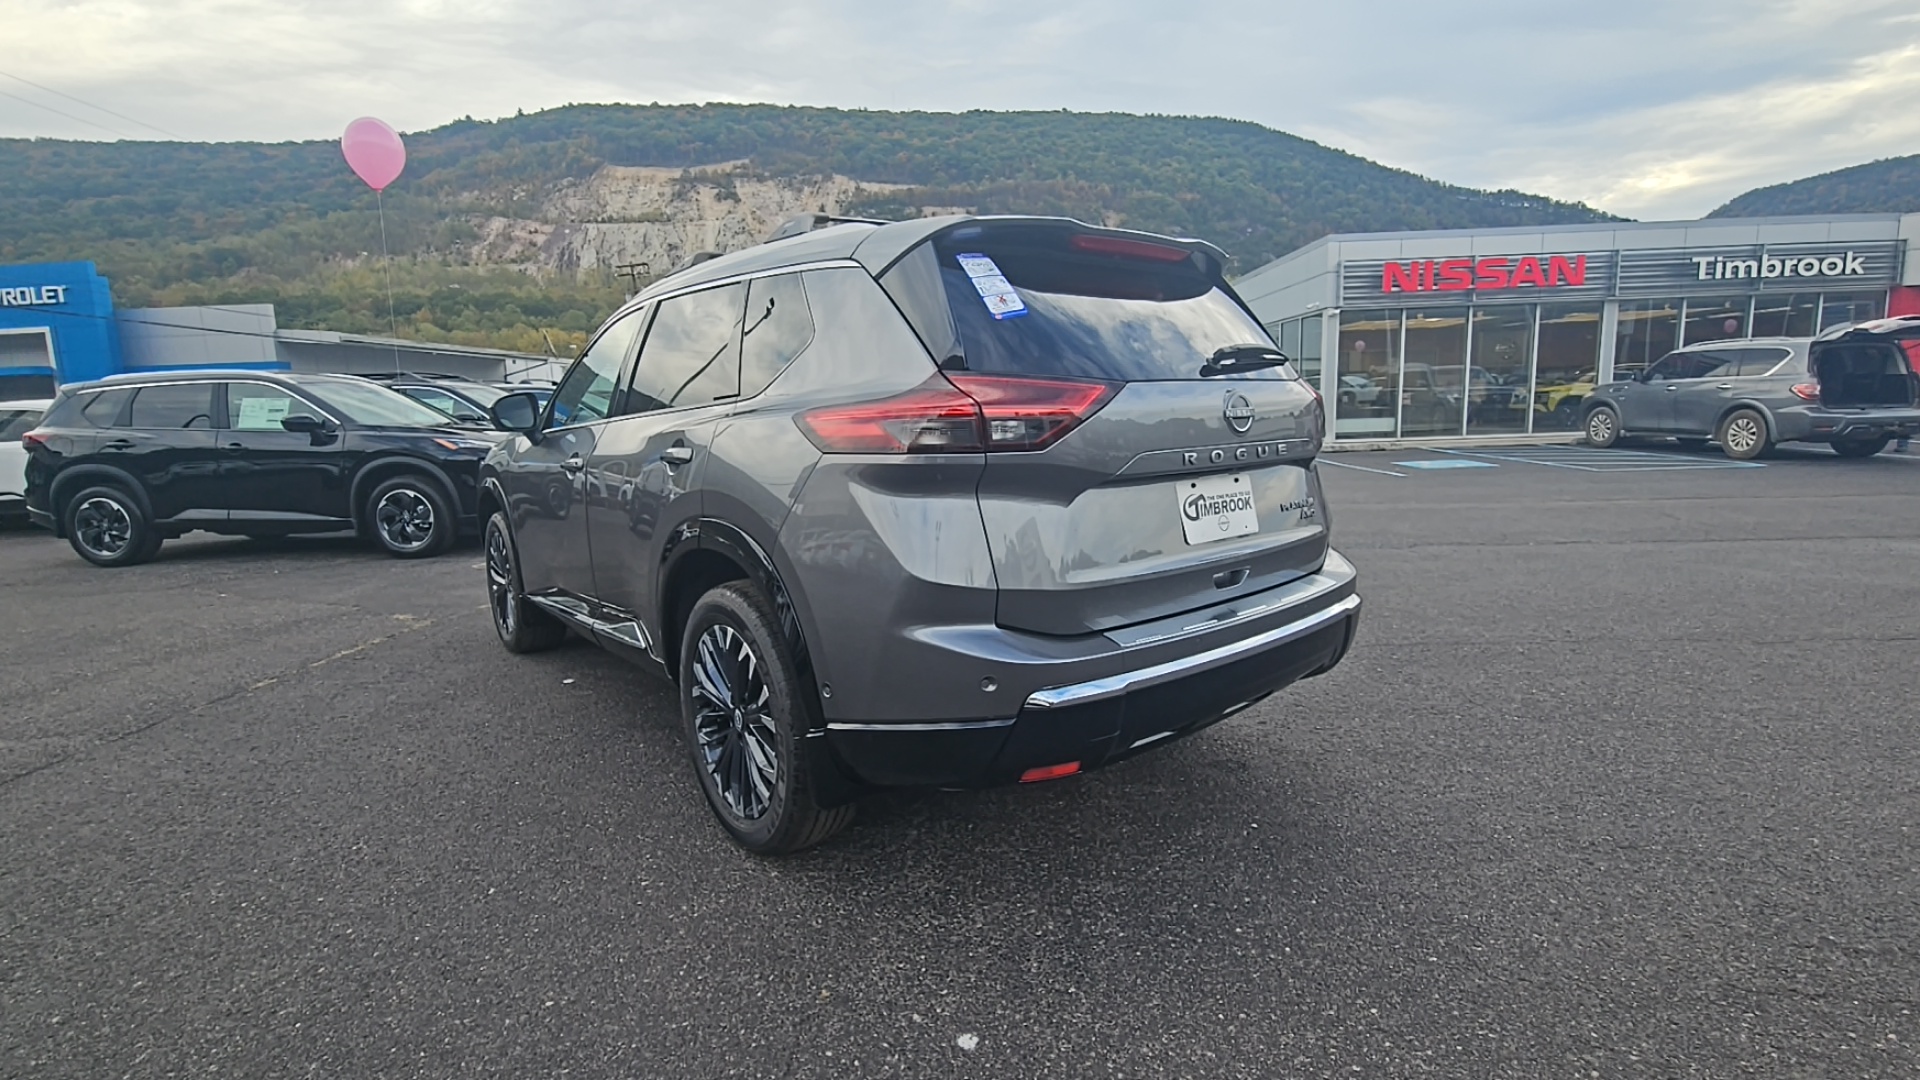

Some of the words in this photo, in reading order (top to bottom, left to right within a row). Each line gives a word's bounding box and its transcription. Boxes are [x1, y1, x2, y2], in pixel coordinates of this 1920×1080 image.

[1382, 254, 1587, 294] NISSAN
[1691, 251, 1866, 280] Timbrook
[0, 285, 67, 306] ROLET
[1183, 443, 1288, 466] ROGUE
[1183, 494, 1252, 521] TIMBROOK
